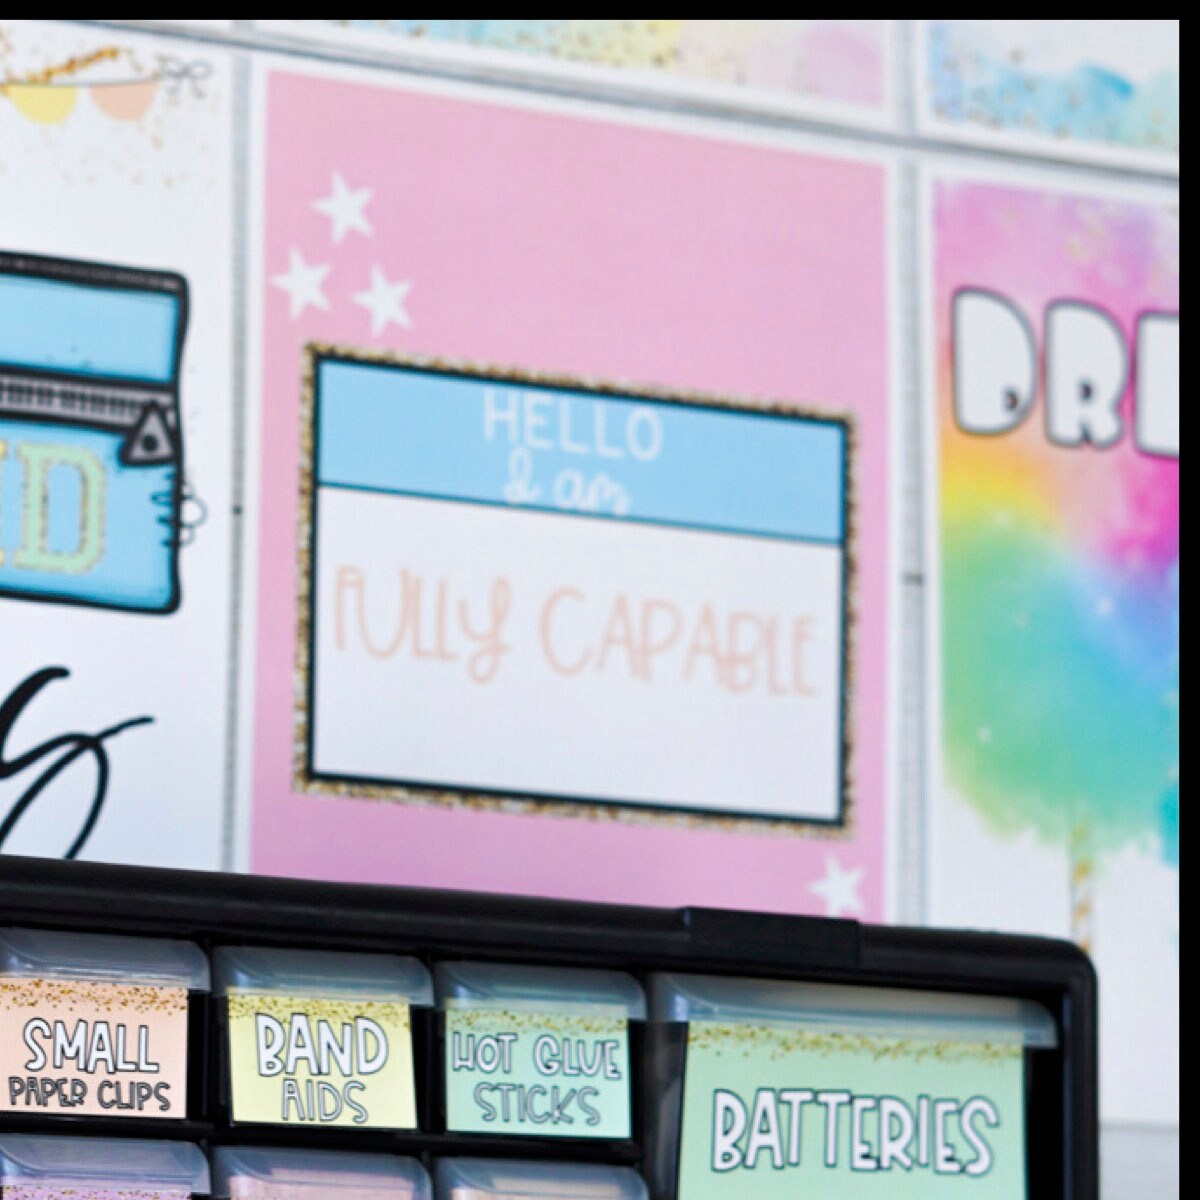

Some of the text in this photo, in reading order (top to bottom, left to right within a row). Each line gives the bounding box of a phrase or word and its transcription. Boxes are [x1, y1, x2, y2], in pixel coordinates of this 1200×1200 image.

[481, 389, 664, 461] HELLO
[553, 467, 631, 516] am
[539, 586, 818, 697] CAPABLE
[24, 1018, 159, 1074] SMALL
[255, 1012, 389, 1077] BAND
[451, 1031, 622, 1079] HOT GLUE
[8, 1076, 171, 1111] PAPER CLIPS
[282, 1079, 369, 1124] AIDS
[473, 1082, 601, 1126] STICKS
[710, 1088, 1000, 1176] BATTERIES
